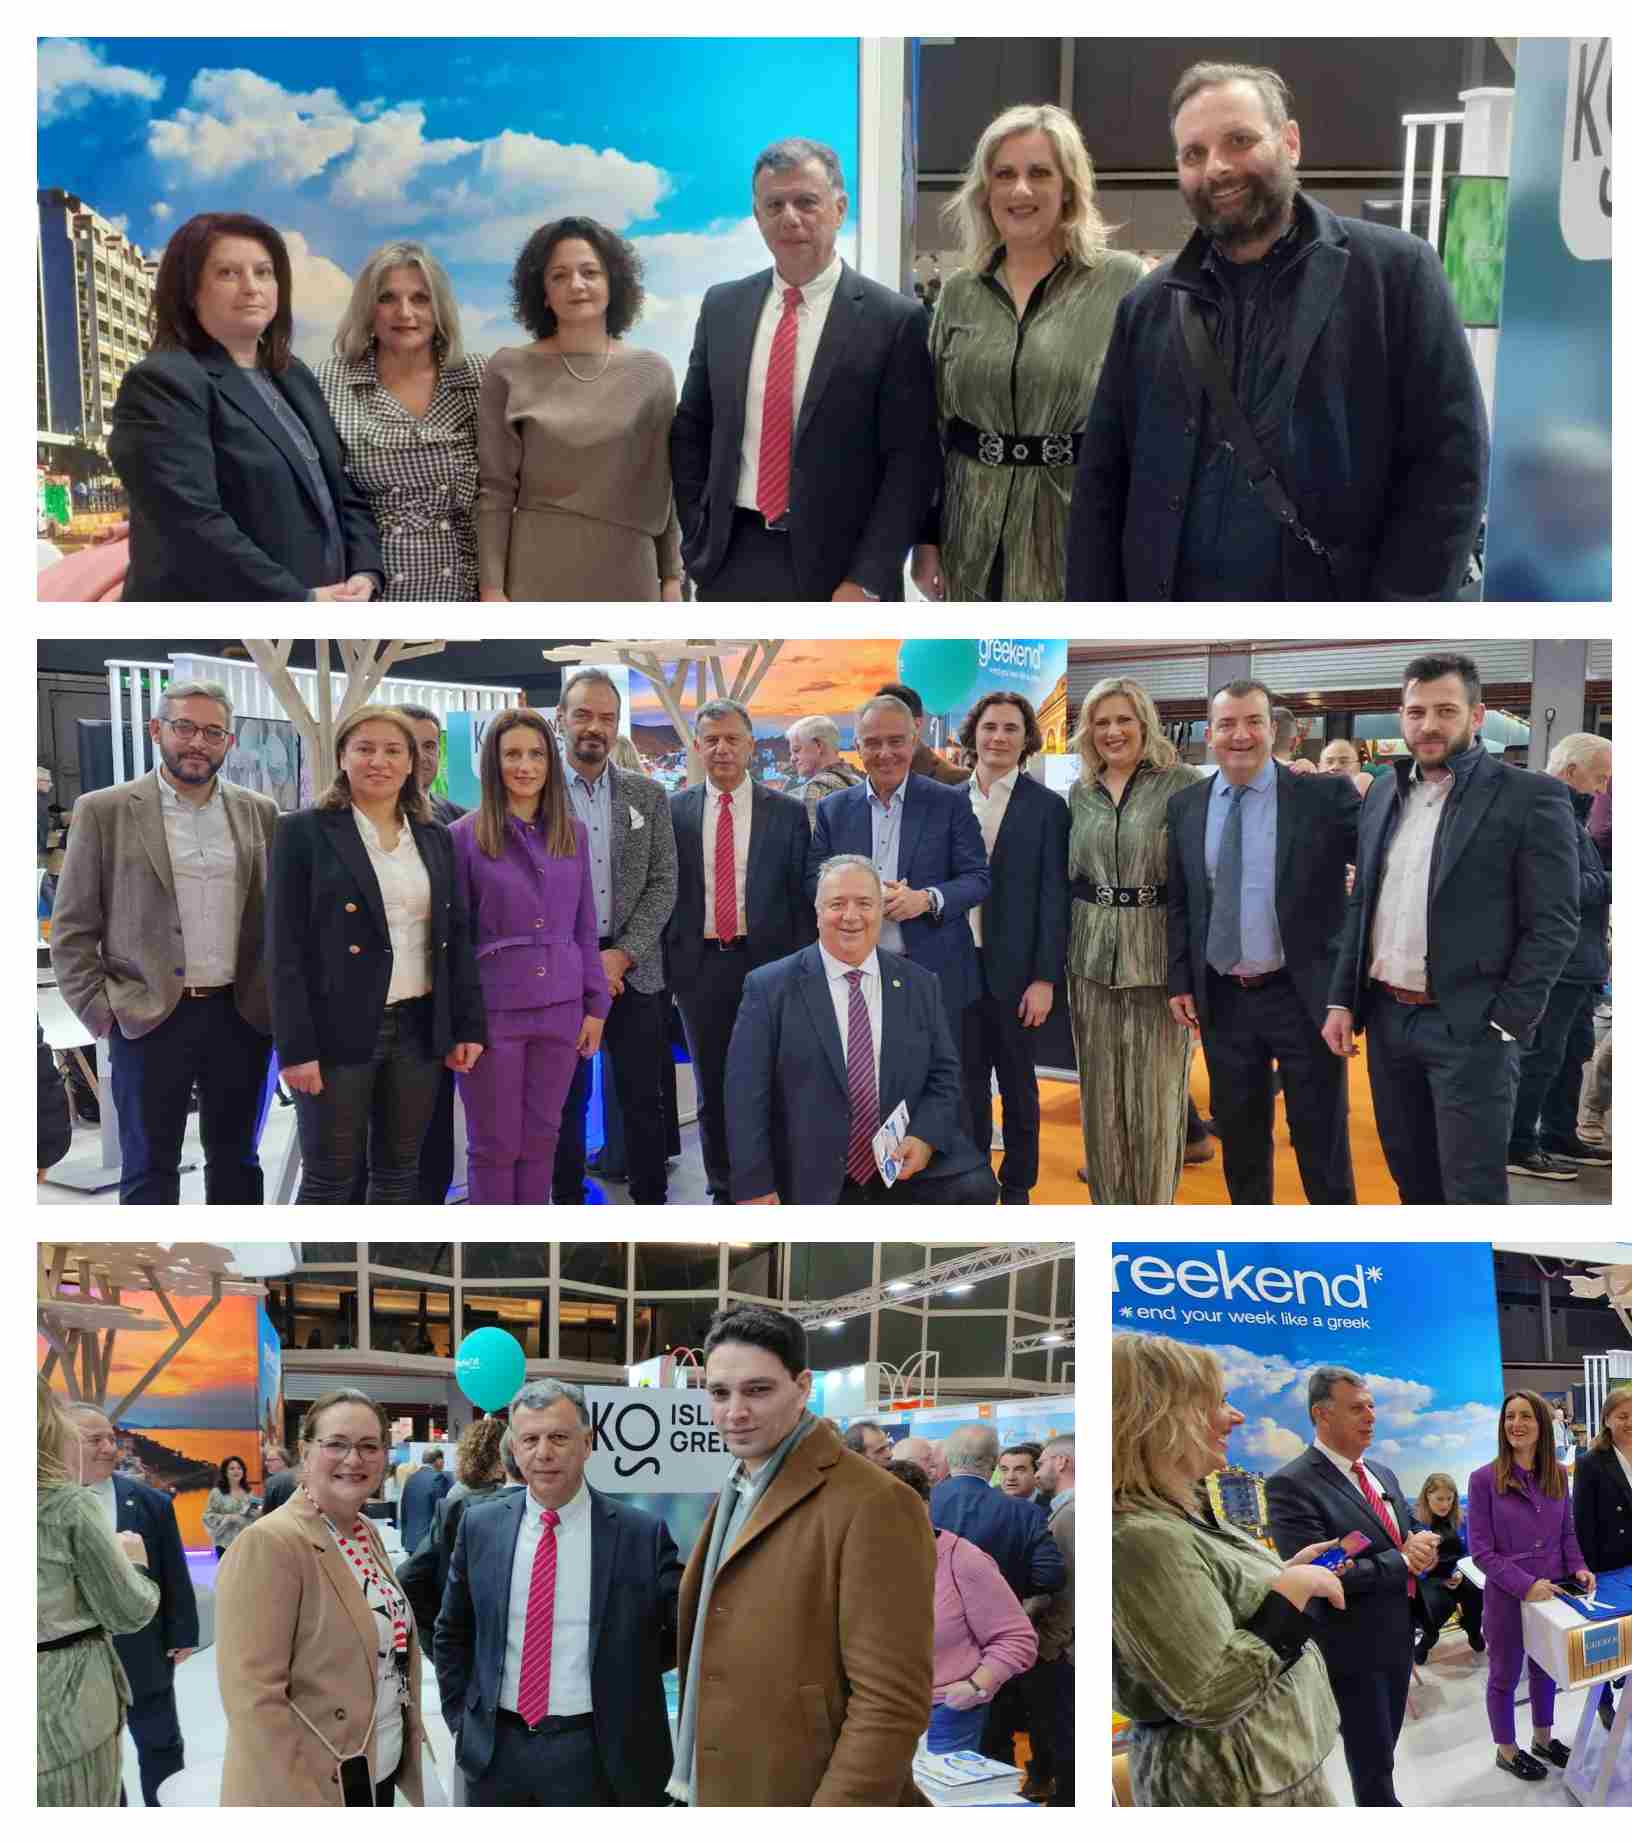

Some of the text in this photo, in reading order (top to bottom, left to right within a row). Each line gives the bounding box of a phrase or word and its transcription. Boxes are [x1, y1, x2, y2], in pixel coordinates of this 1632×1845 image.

[1181, 1309, 1222, 1325] your
[1228, 1311, 1277, 1325] week
[1281, 1312, 1309, 1327] like
[1312, 1317, 1323, 1328] a
[1327, 1317, 1371, 1330] greek
[671, 1404, 714, 1426] ISL
[669, 1431, 730, 1453] GRE
